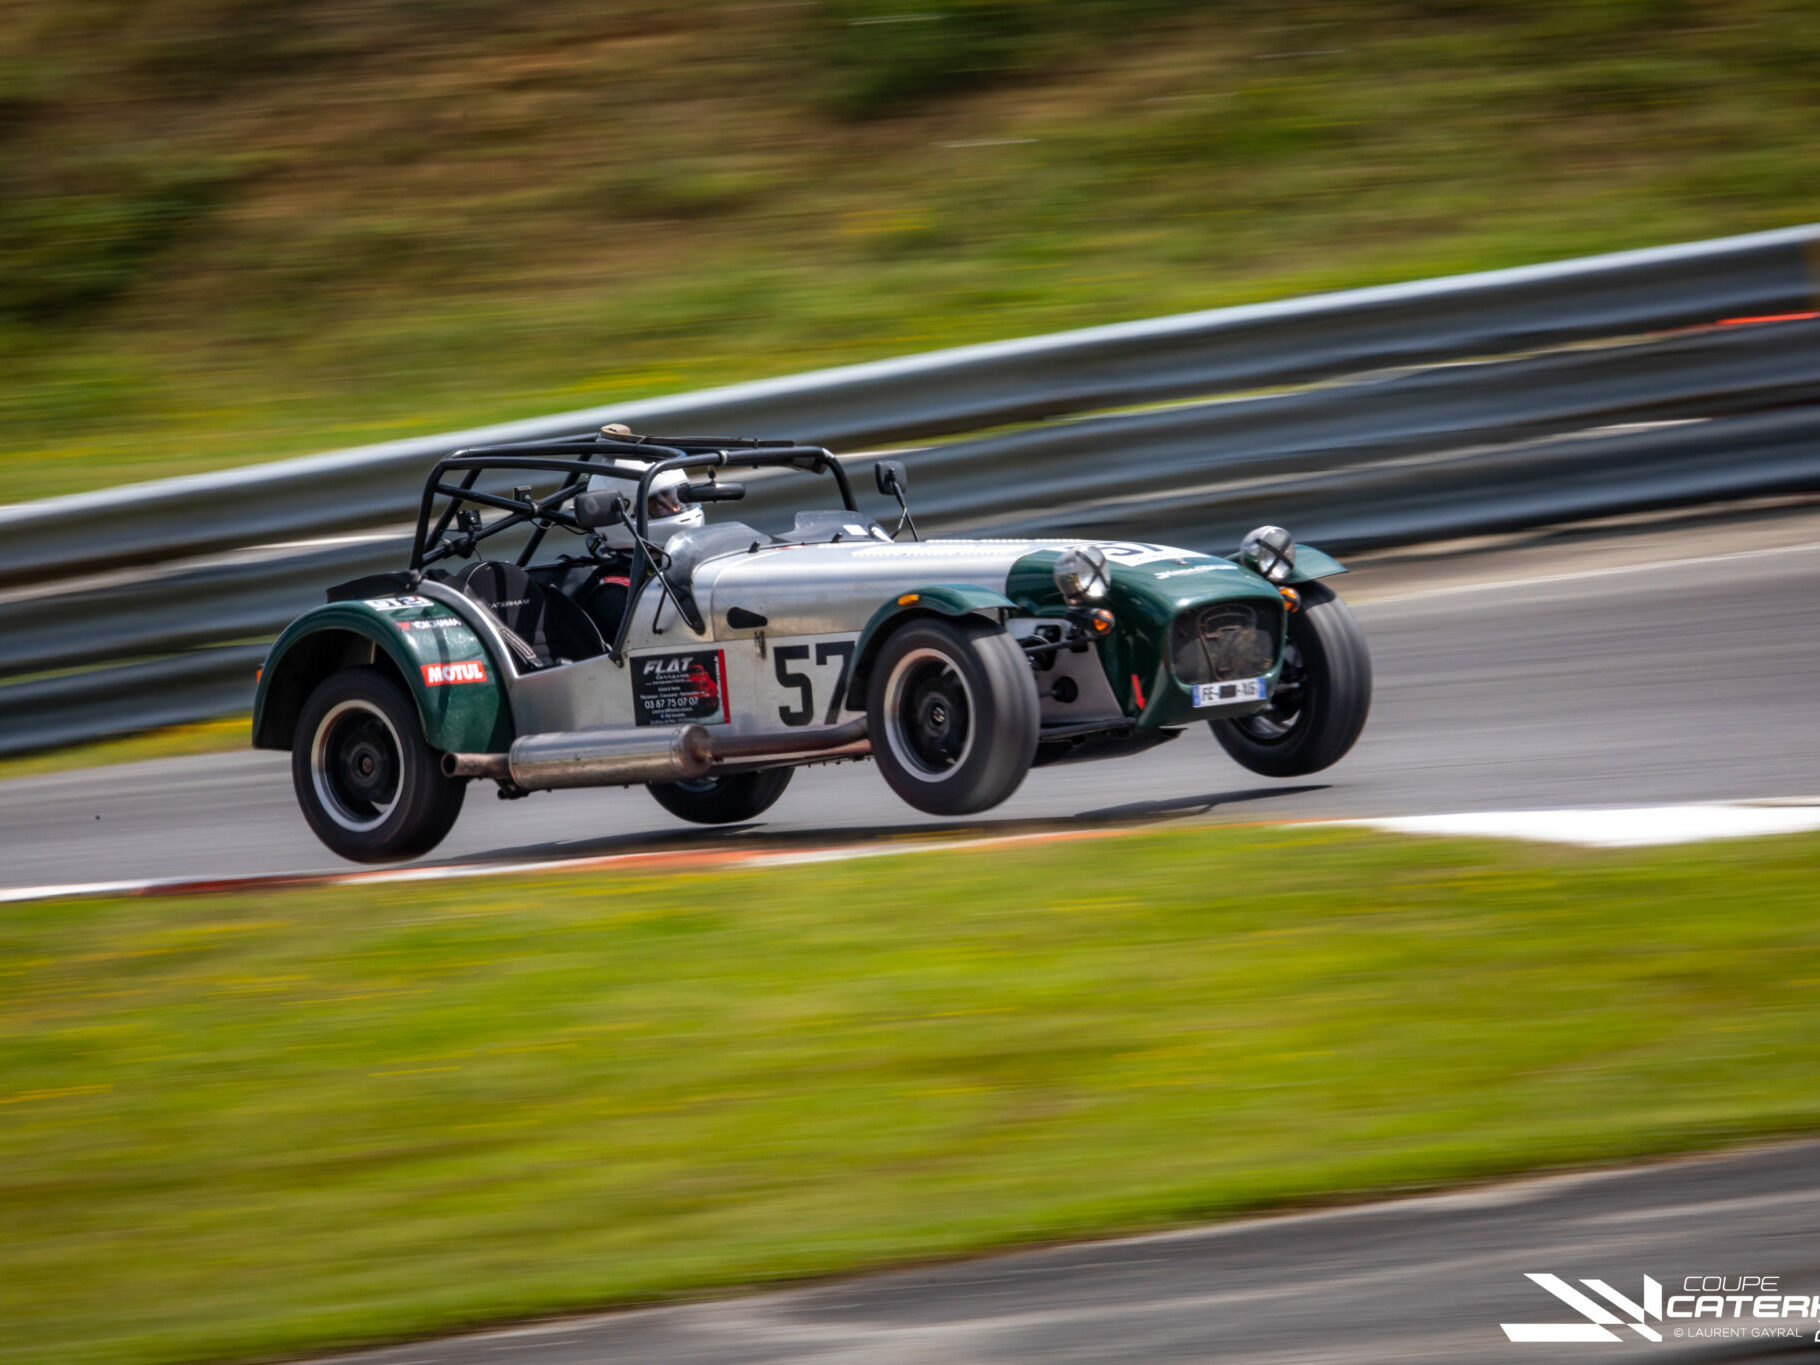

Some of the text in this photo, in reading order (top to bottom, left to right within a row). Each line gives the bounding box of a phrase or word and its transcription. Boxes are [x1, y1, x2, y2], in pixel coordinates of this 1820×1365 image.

[427, 663, 483, 683] MOTUL
[643, 657, 694, 675] FLAT
[772, 640, 856, 728] 57
